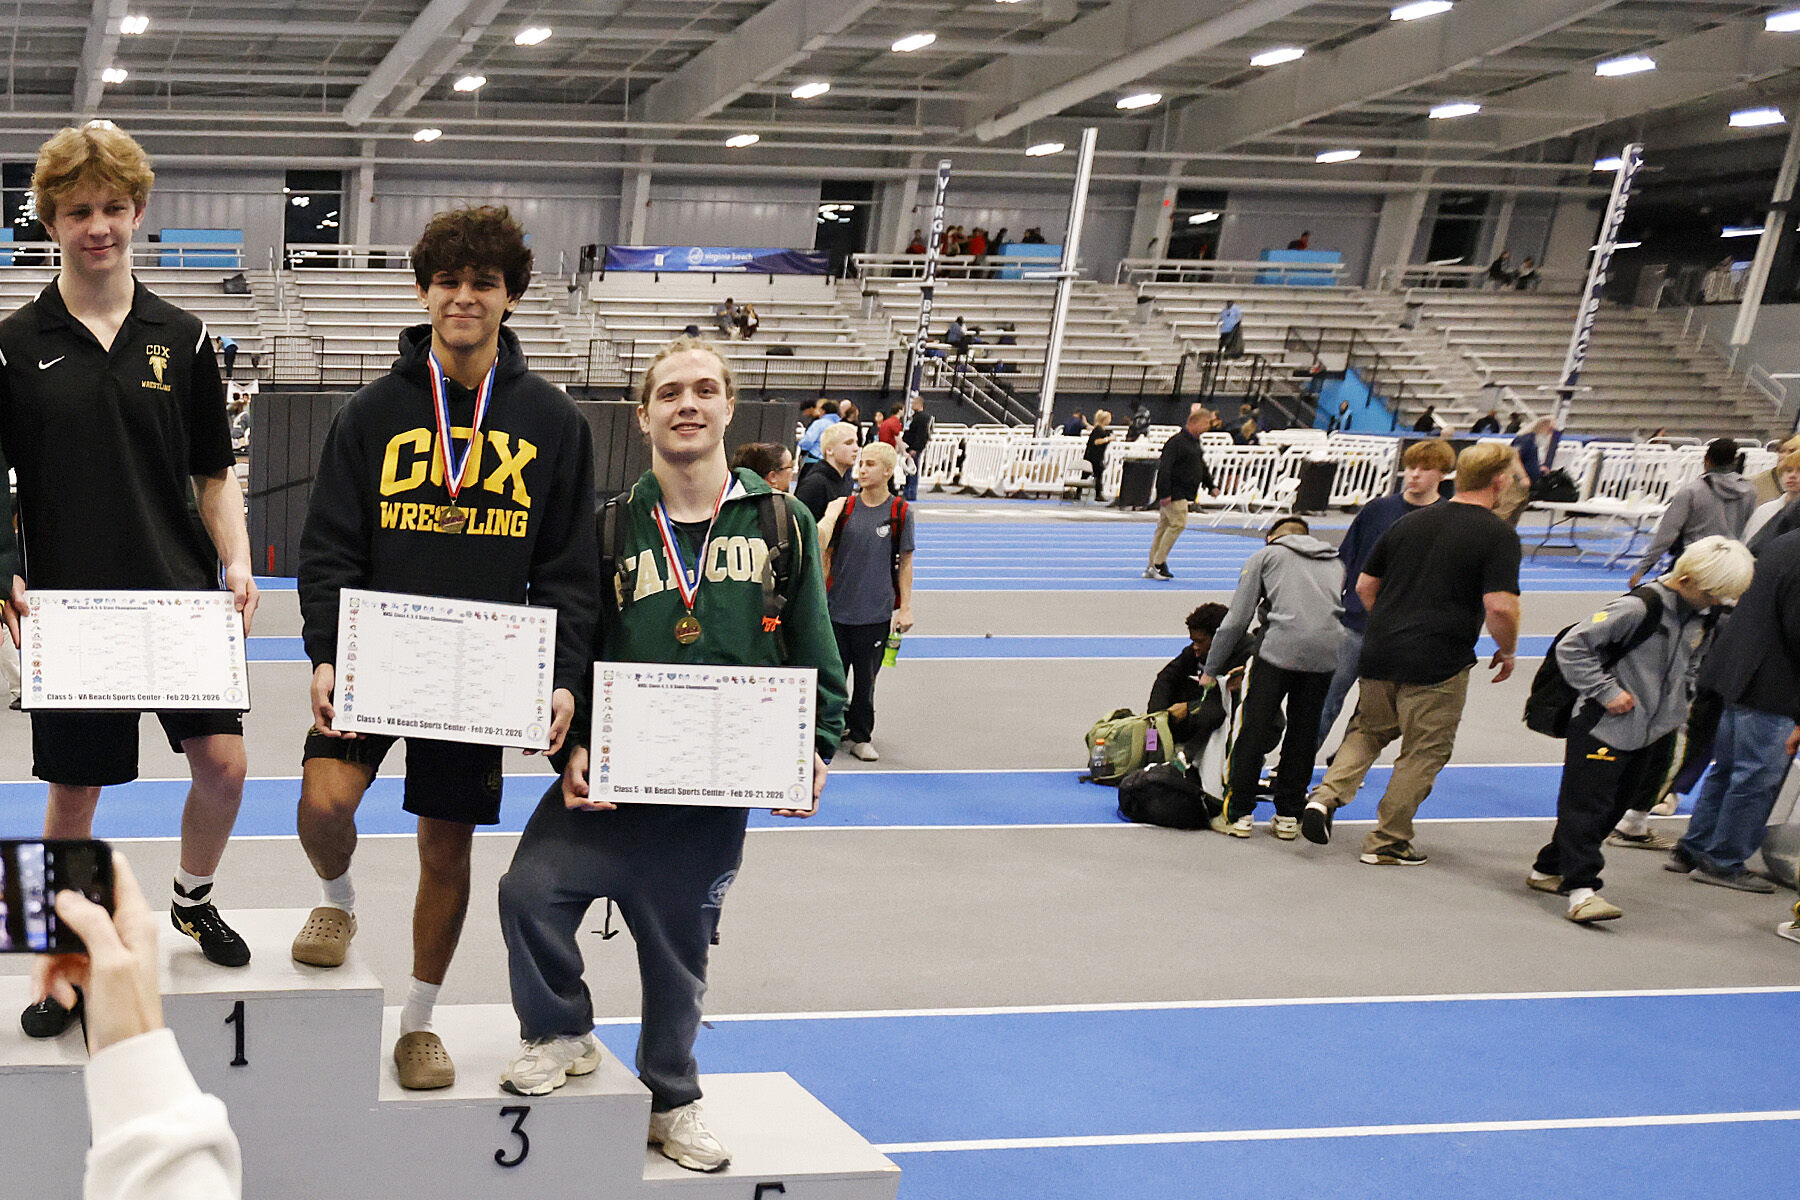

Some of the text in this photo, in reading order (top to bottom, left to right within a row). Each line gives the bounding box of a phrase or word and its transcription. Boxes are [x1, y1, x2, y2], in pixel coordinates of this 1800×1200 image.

[146, 345, 170, 358] COX
[914, 300, 932, 366] BEACH
[380, 427, 537, 508] COX
[112, 693, 136, 702] Sports
[137, 693, 161, 701] Center
[166, 693, 179, 701] Feb
[356, 714, 376, 724] Class
[377, 716, 382, 724] 5
[397, 718, 419, 728] Beach
[420, 720, 442, 730] Sports
[443, 722, 466, 732] Center
[471, 725, 483, 733] Feb
[505, 728, 523, 738] 2026
[613, 785, 633, 793] Class
[654, 787, 676, 795] Beach
[677, 787, 700, 796] Sports
[702, 788, 726, 797] Center
[225, 1001, 249, 1066] 1
[495, 1106, 531, 1168] 3
